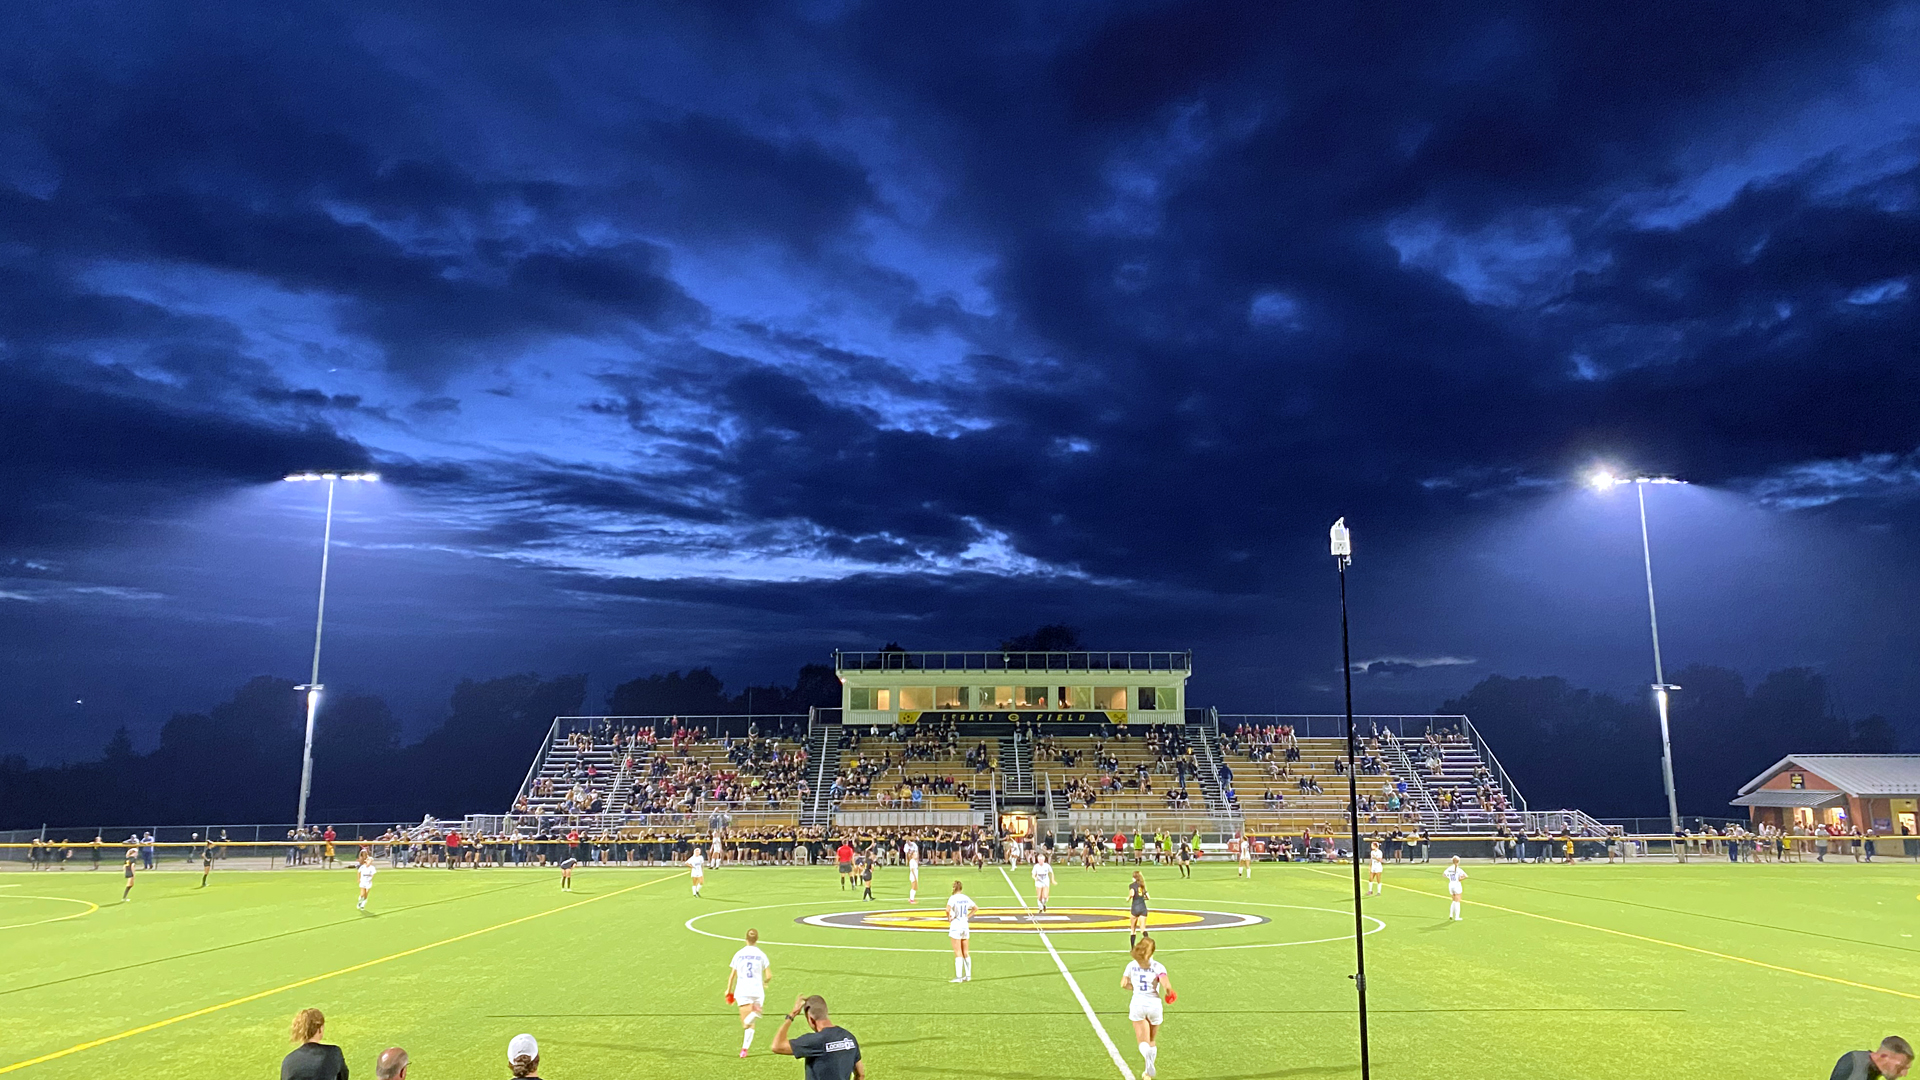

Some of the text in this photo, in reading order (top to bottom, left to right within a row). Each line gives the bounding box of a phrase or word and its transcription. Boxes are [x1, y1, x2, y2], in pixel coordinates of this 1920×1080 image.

[960, 904, 968, 918] 14
[746, 961, 754, 978] 3
[1139, 974, 1148, 991] 5
